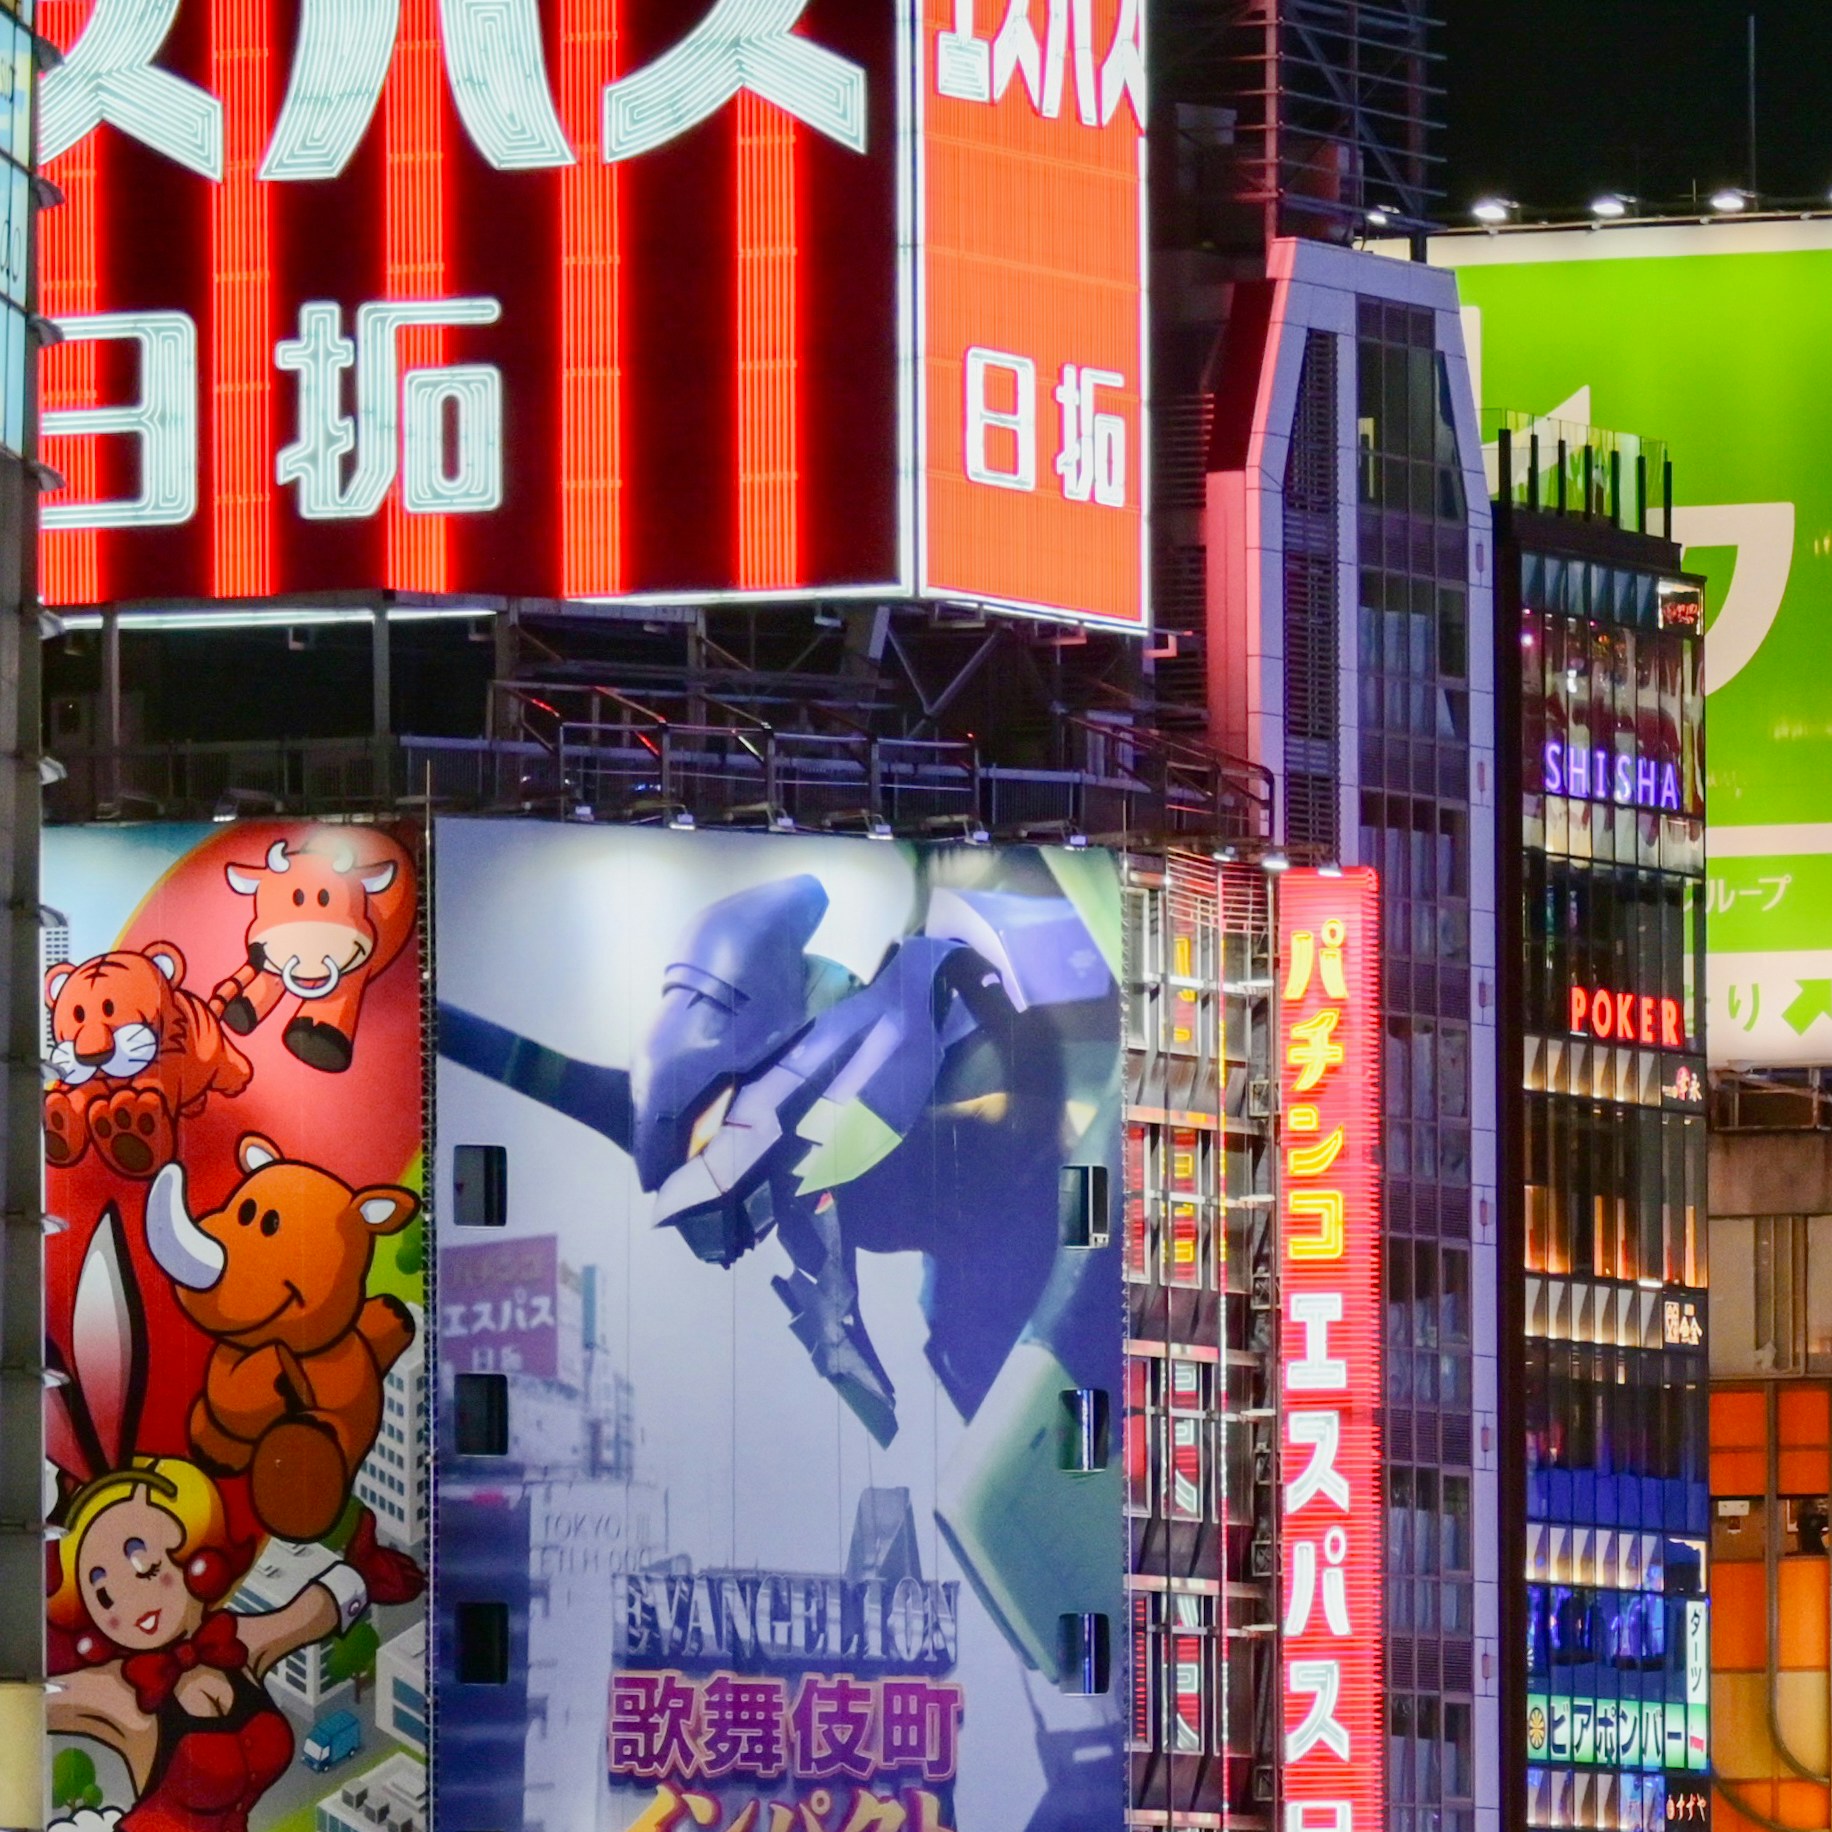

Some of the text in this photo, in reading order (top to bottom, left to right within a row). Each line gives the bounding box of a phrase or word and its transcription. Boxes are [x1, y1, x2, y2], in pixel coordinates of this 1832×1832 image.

[965, 347, 1128, 507] 日拓
[1545, 743, 1679, 810] SHISHA
[1571, 986, 1681, 1046] POKER
[443, 1287, 555, 1339] エスパス
[625, 1574, 962, 1664] EVANGELION
[1690, 1609, 1703, 1692] ダーツ
[607, 1669, 967, 1780] 歌舞伎町
